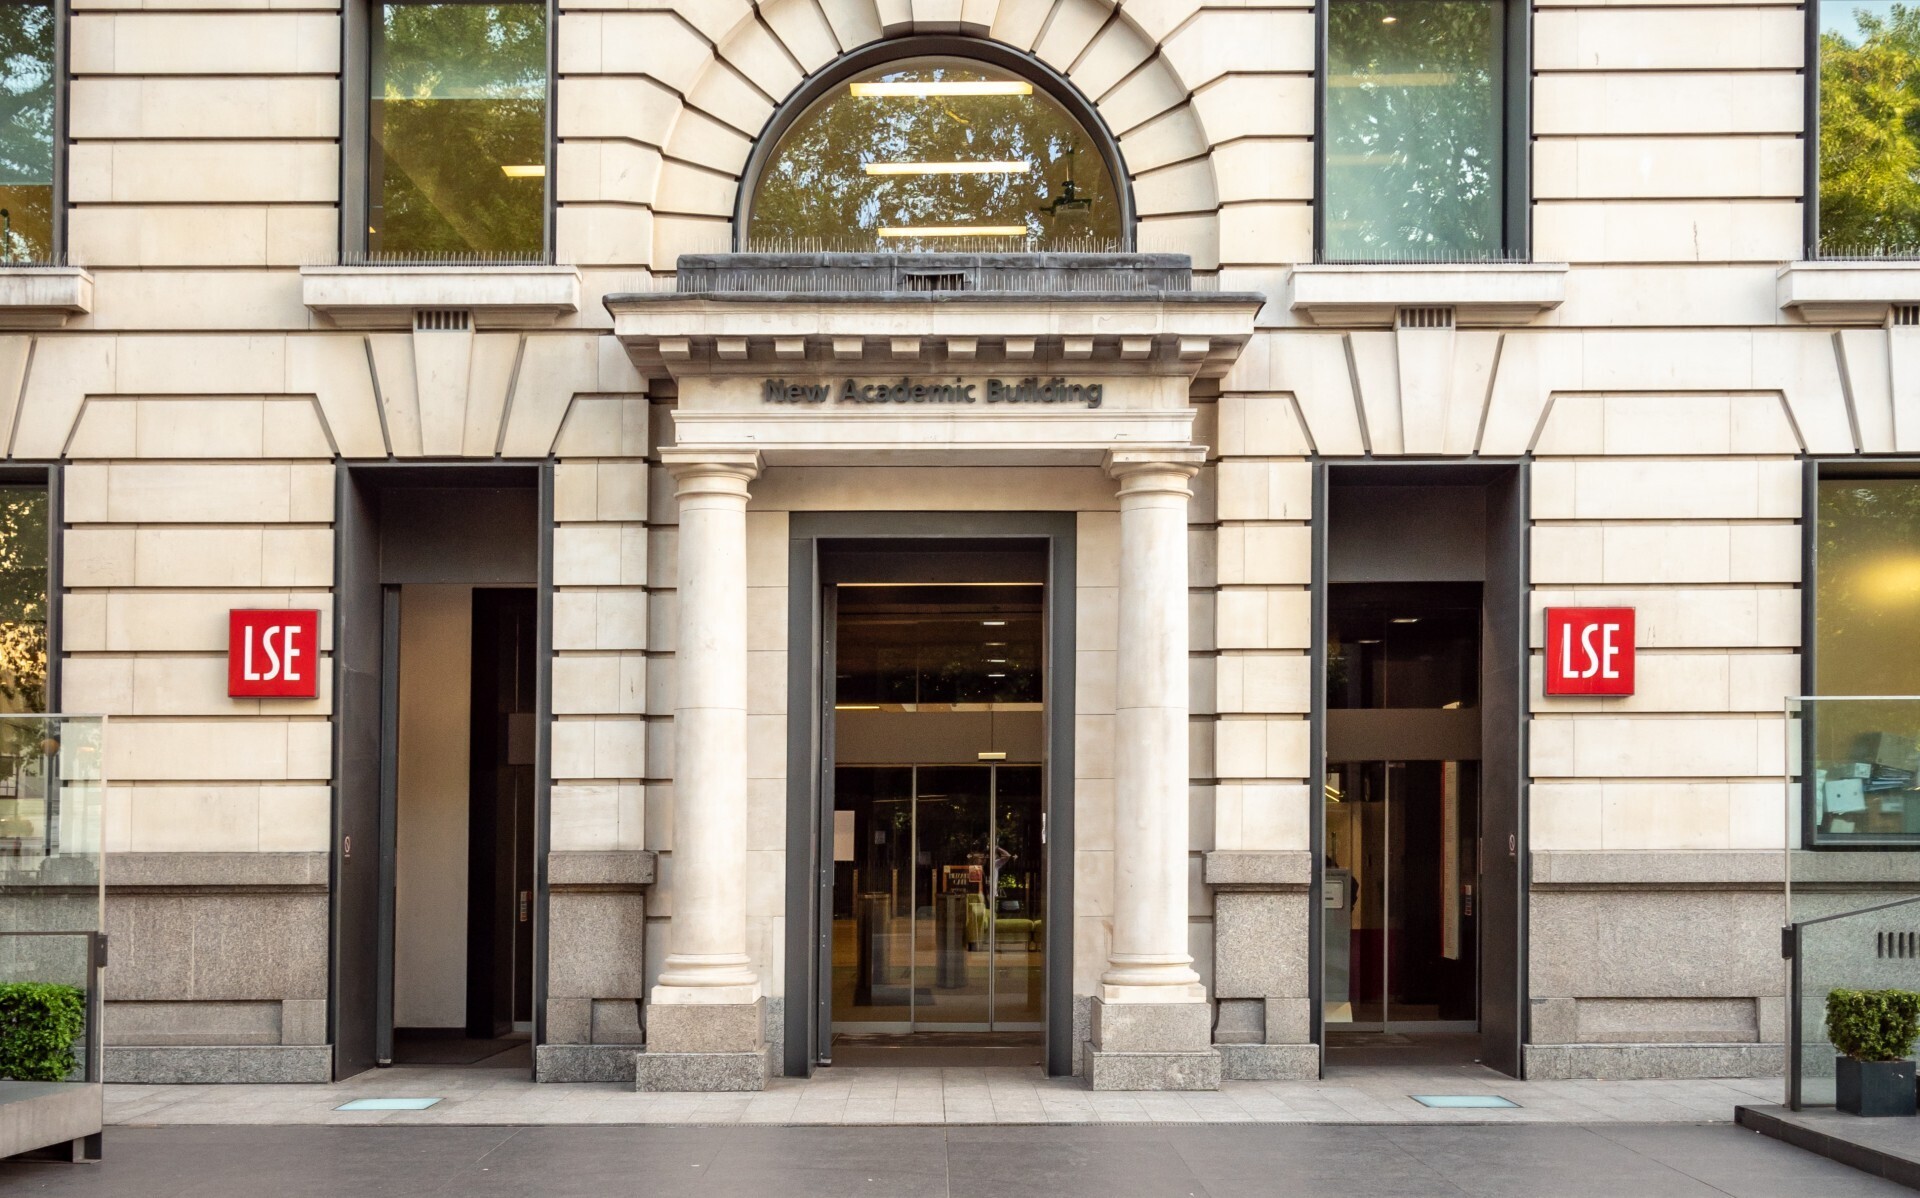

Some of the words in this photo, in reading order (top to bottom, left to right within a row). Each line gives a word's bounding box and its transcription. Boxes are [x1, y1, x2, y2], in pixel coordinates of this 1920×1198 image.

[764, 379, 830, 403] New
[839, 377, 977, 403] Academic
[986, 377, 1104, 409] Building
[244, 625, 302, 681] LSE
[1562, 623, 1620, 679] LSE
